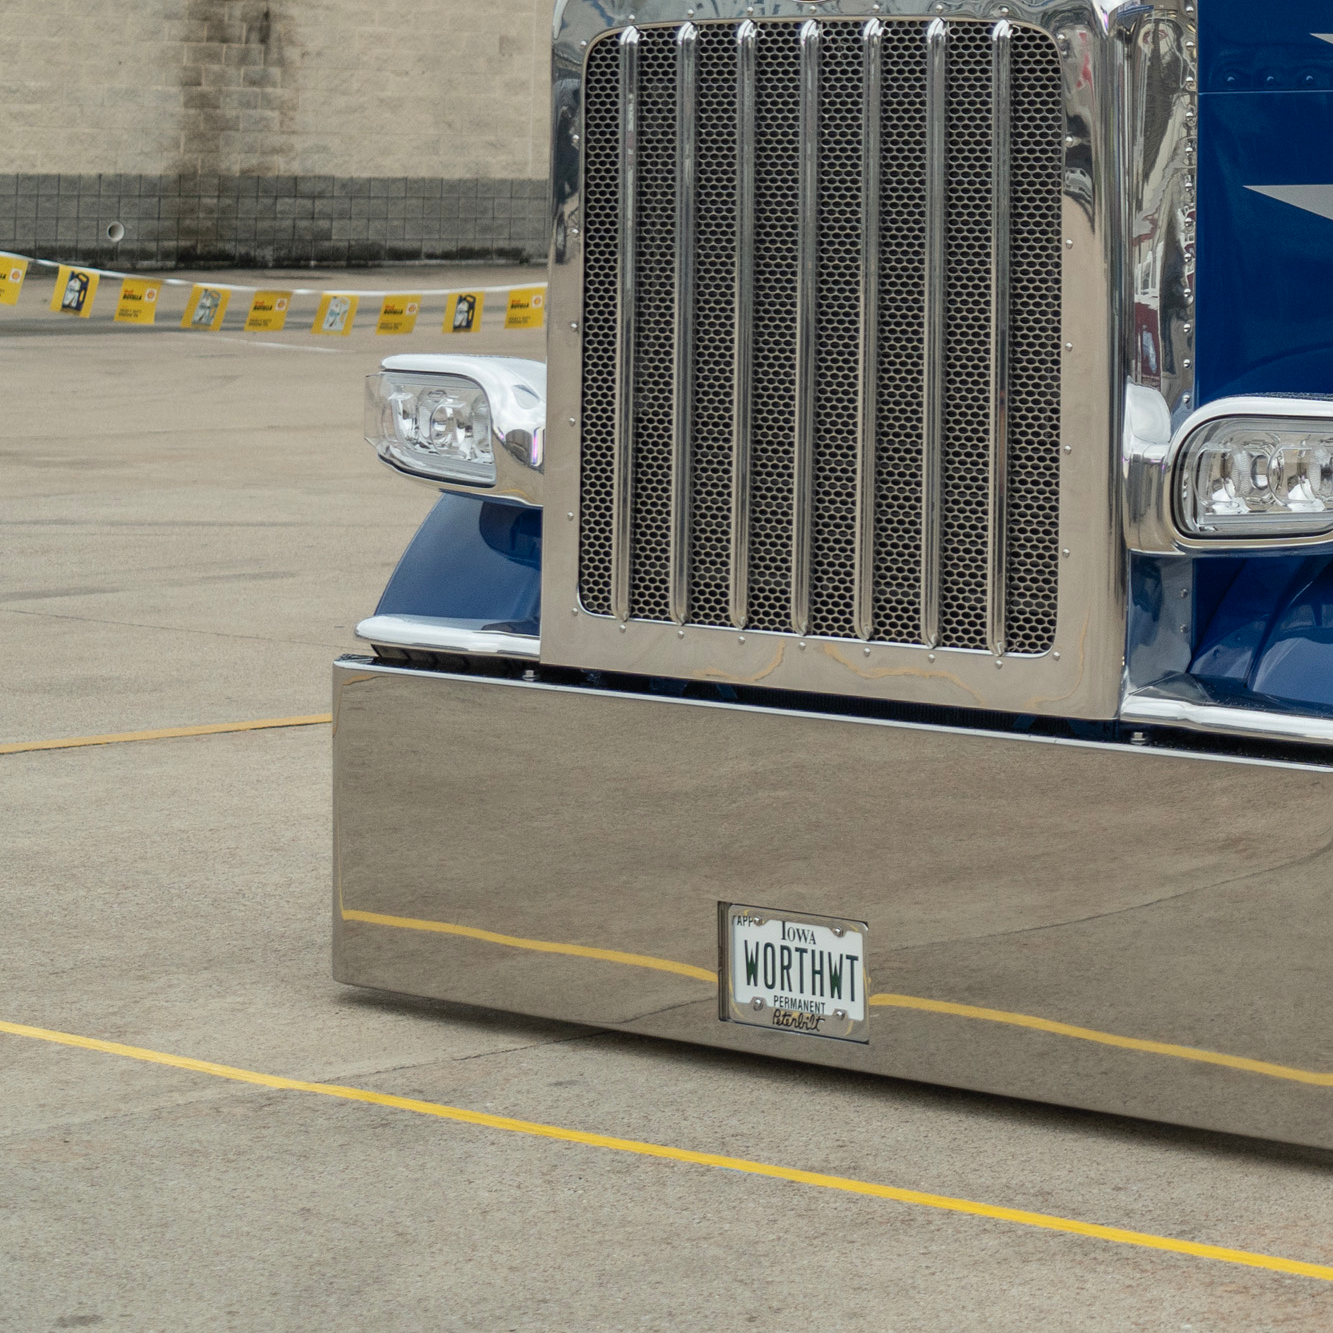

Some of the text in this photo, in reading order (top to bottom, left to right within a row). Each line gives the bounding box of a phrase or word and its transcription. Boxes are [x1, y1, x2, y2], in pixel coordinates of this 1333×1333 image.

[744, 939, 860, 1002] WORTHWT
[773, 995, 826, 1015] PERMANENT
[772, 1009, 826, 1032] Peterbilt
